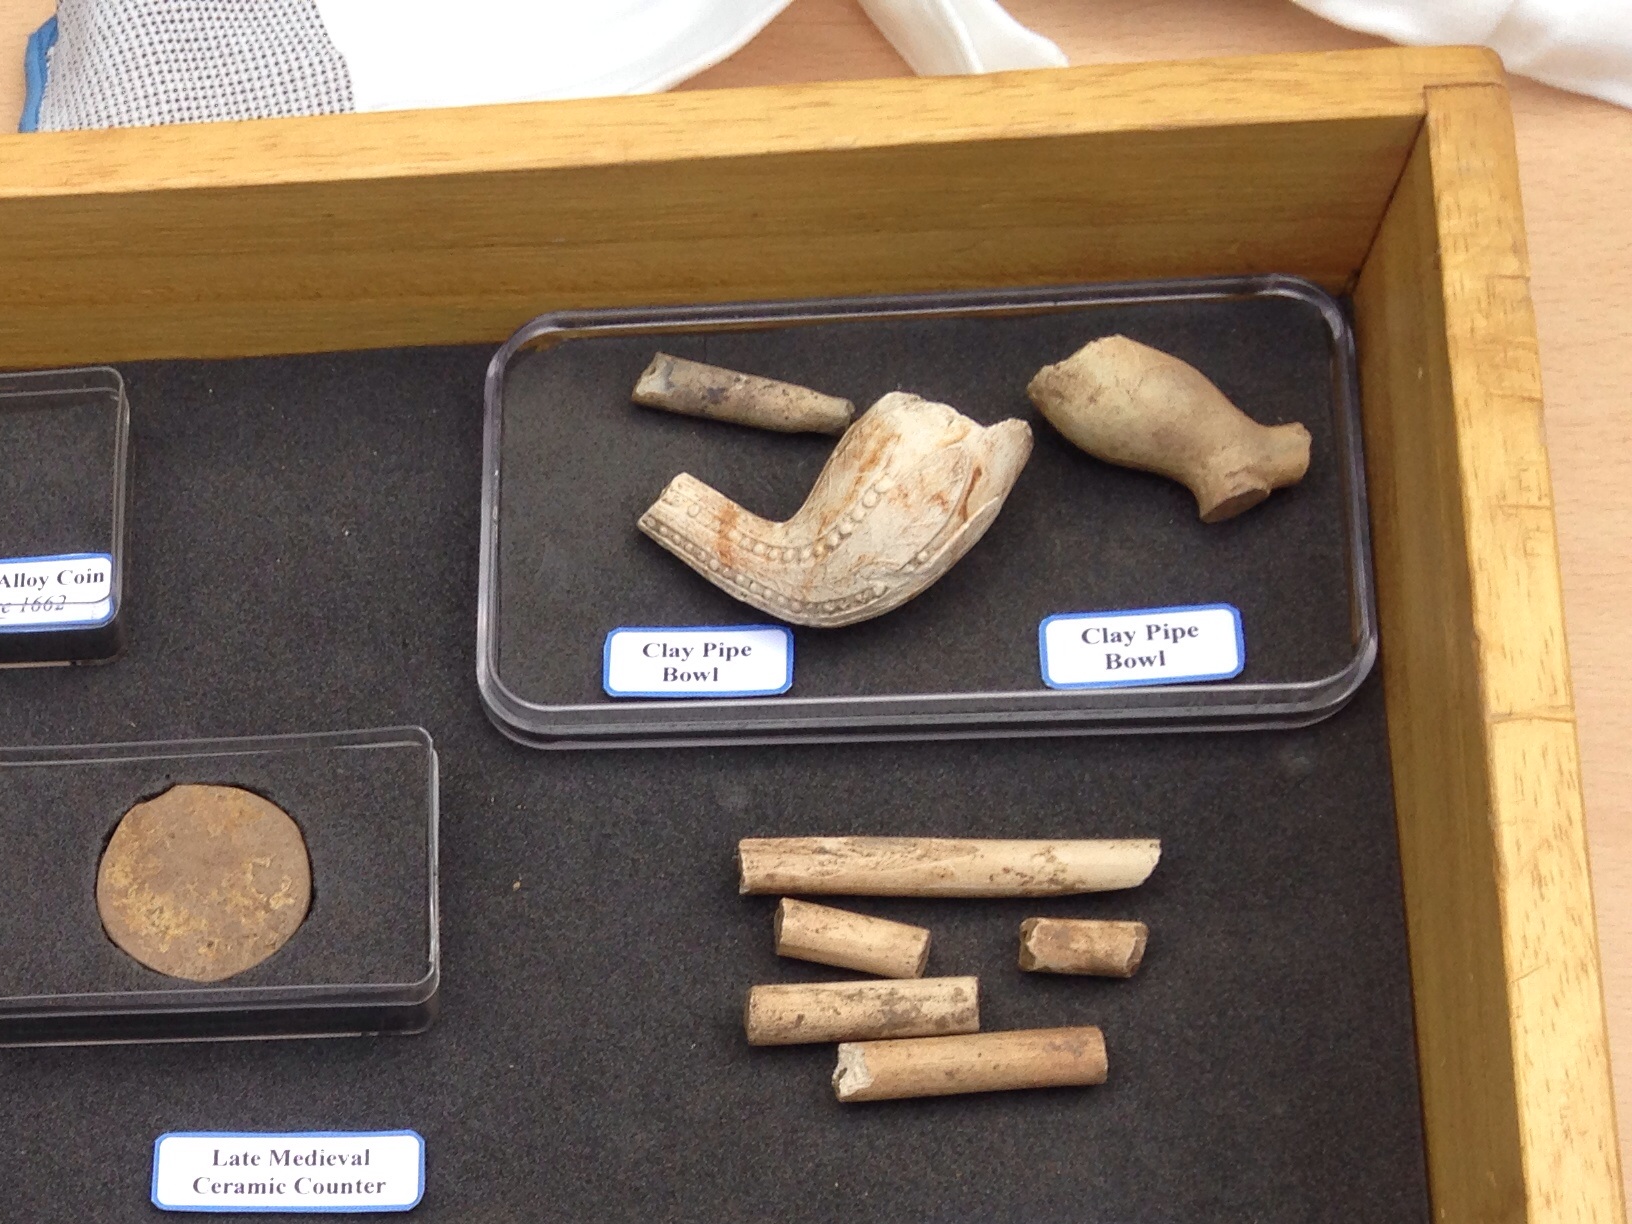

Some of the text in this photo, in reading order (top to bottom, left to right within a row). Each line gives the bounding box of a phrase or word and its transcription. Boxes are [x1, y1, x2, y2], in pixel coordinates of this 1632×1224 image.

[55, 568, 105, 587] Coin
[17, 595, 67, 613] 1662
[1081, 623, 1198, 647] Clay Pipe
[643, 642, 752, 662] Clay Pipe
[1106, 650, 1165, 669] Bowl
[663, 667, 718, 682] Bowl
[213, 1149, 369, 1166] Late Medieval
[193, 1177, 386, 1194] Ceramic Counter
